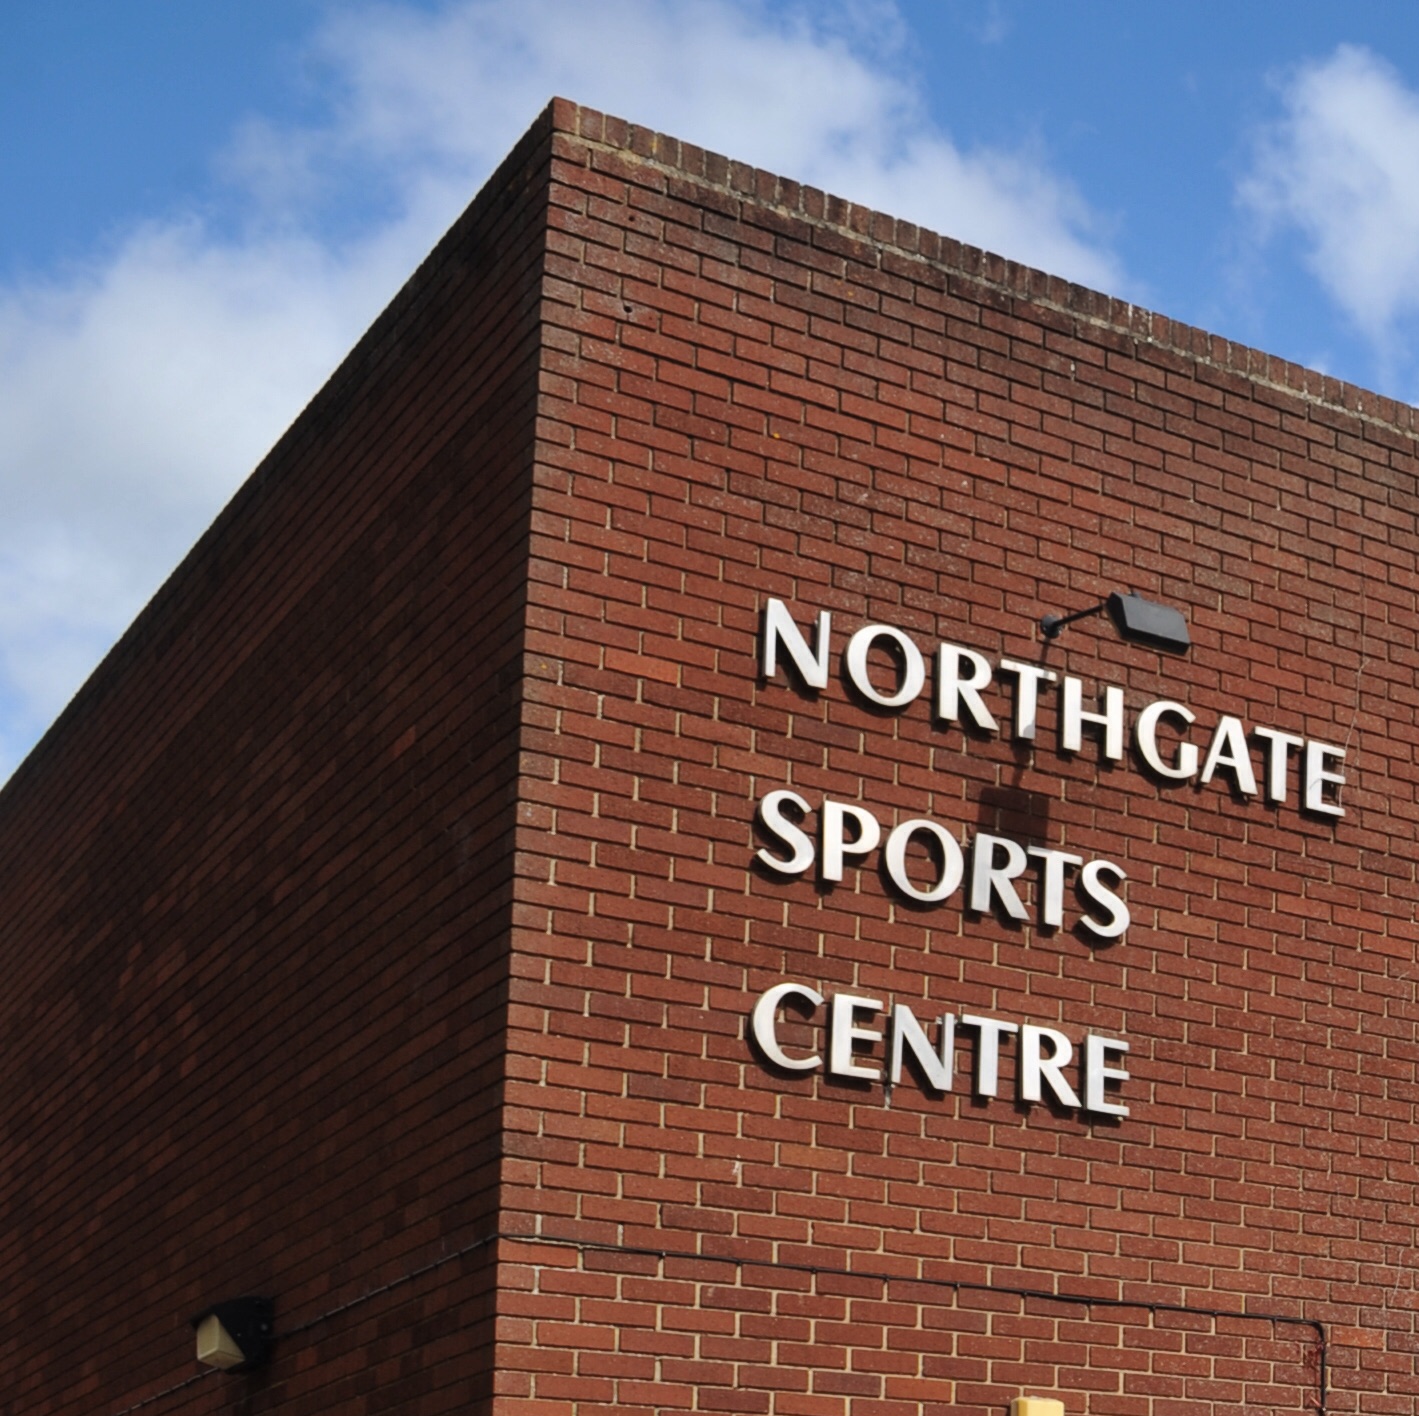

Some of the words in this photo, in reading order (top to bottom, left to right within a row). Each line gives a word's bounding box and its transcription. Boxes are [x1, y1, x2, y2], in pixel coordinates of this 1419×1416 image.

[764, 597, 1347, 818] NORTHGATE
[756, 789, 1131, 938] SPORTS
[752, 983, 1130, 1117] CENTRE
